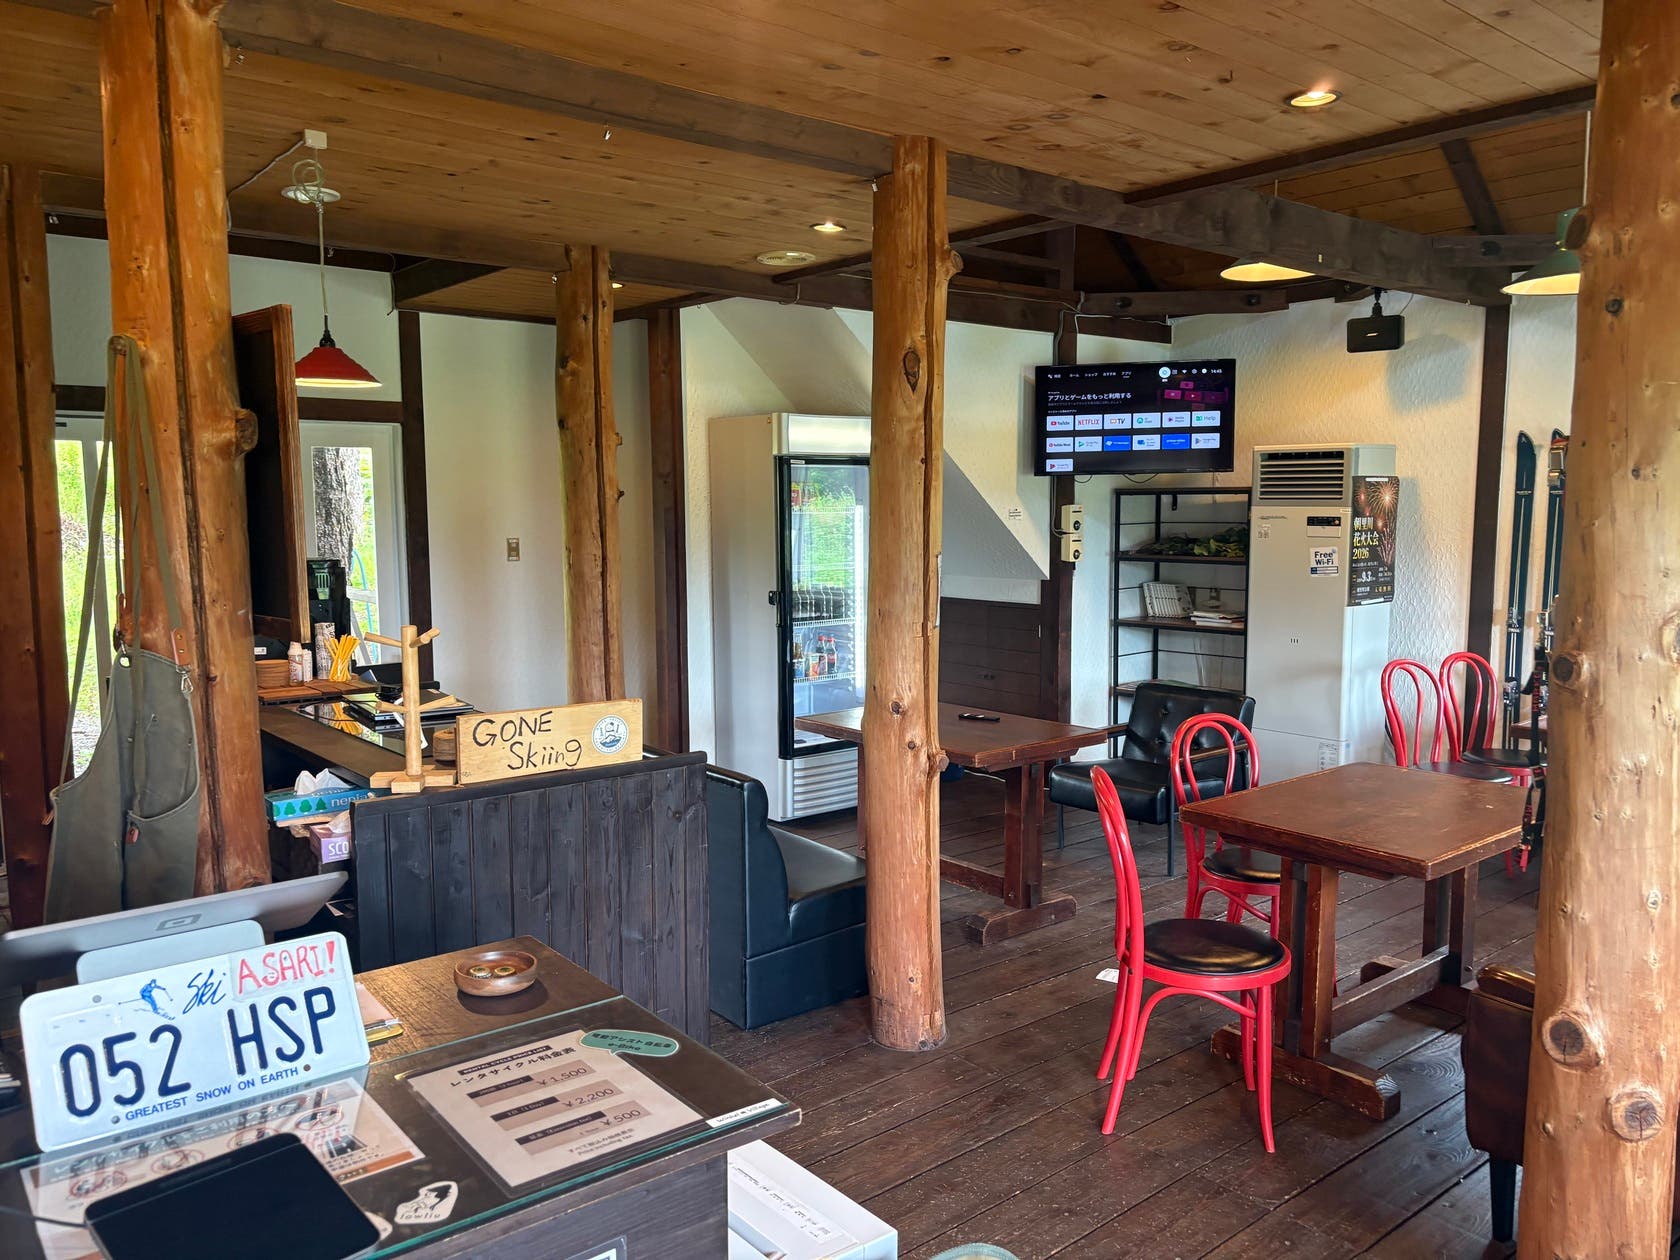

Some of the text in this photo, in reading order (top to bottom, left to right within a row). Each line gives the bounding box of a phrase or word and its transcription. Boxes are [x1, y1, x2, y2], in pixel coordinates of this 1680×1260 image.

[1048, 392, 1132, 402] アプリとゲームをもっと利用する
[1314, 551, 1333, 559] Free
[1353, 531, 1379, 546] 花火大会
[1315, 558, 1334, 566] Wi-Fi
[472, 711, 553, 747] GONE
[507, 739, 582, 770] Skiing
[182, 940, 337, 1014] Ski ASARI!
[59, 986, 336, 1118] 052 HSP
[450, 1046, 577, 1087] レンタサイクル料金表
[125, 1066, 298, 1121] GREATEST SNOW ON EARTH
